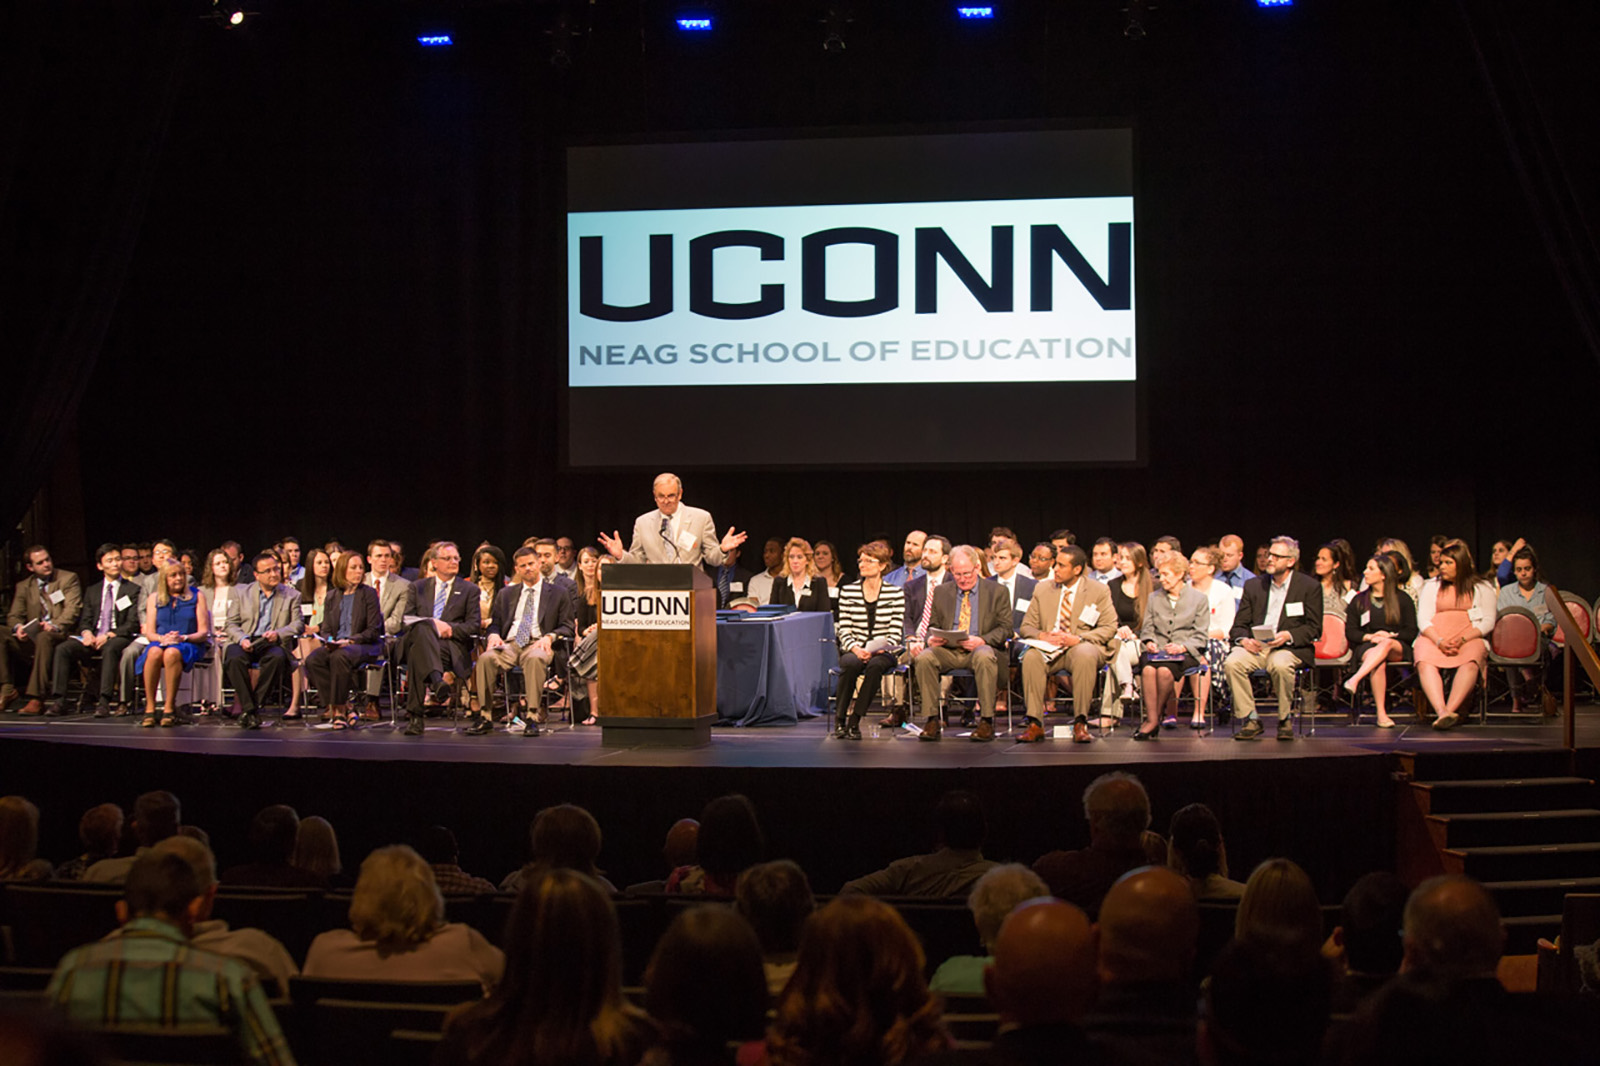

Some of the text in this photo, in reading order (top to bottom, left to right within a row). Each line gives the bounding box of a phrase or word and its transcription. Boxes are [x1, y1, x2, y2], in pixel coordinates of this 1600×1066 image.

[579, 222, 1132, 322] UCONN
[579, 336, 1133, 366] NEAG SCHOOL OF EDUCATION
[602, 596, 689, 615] UCONN
